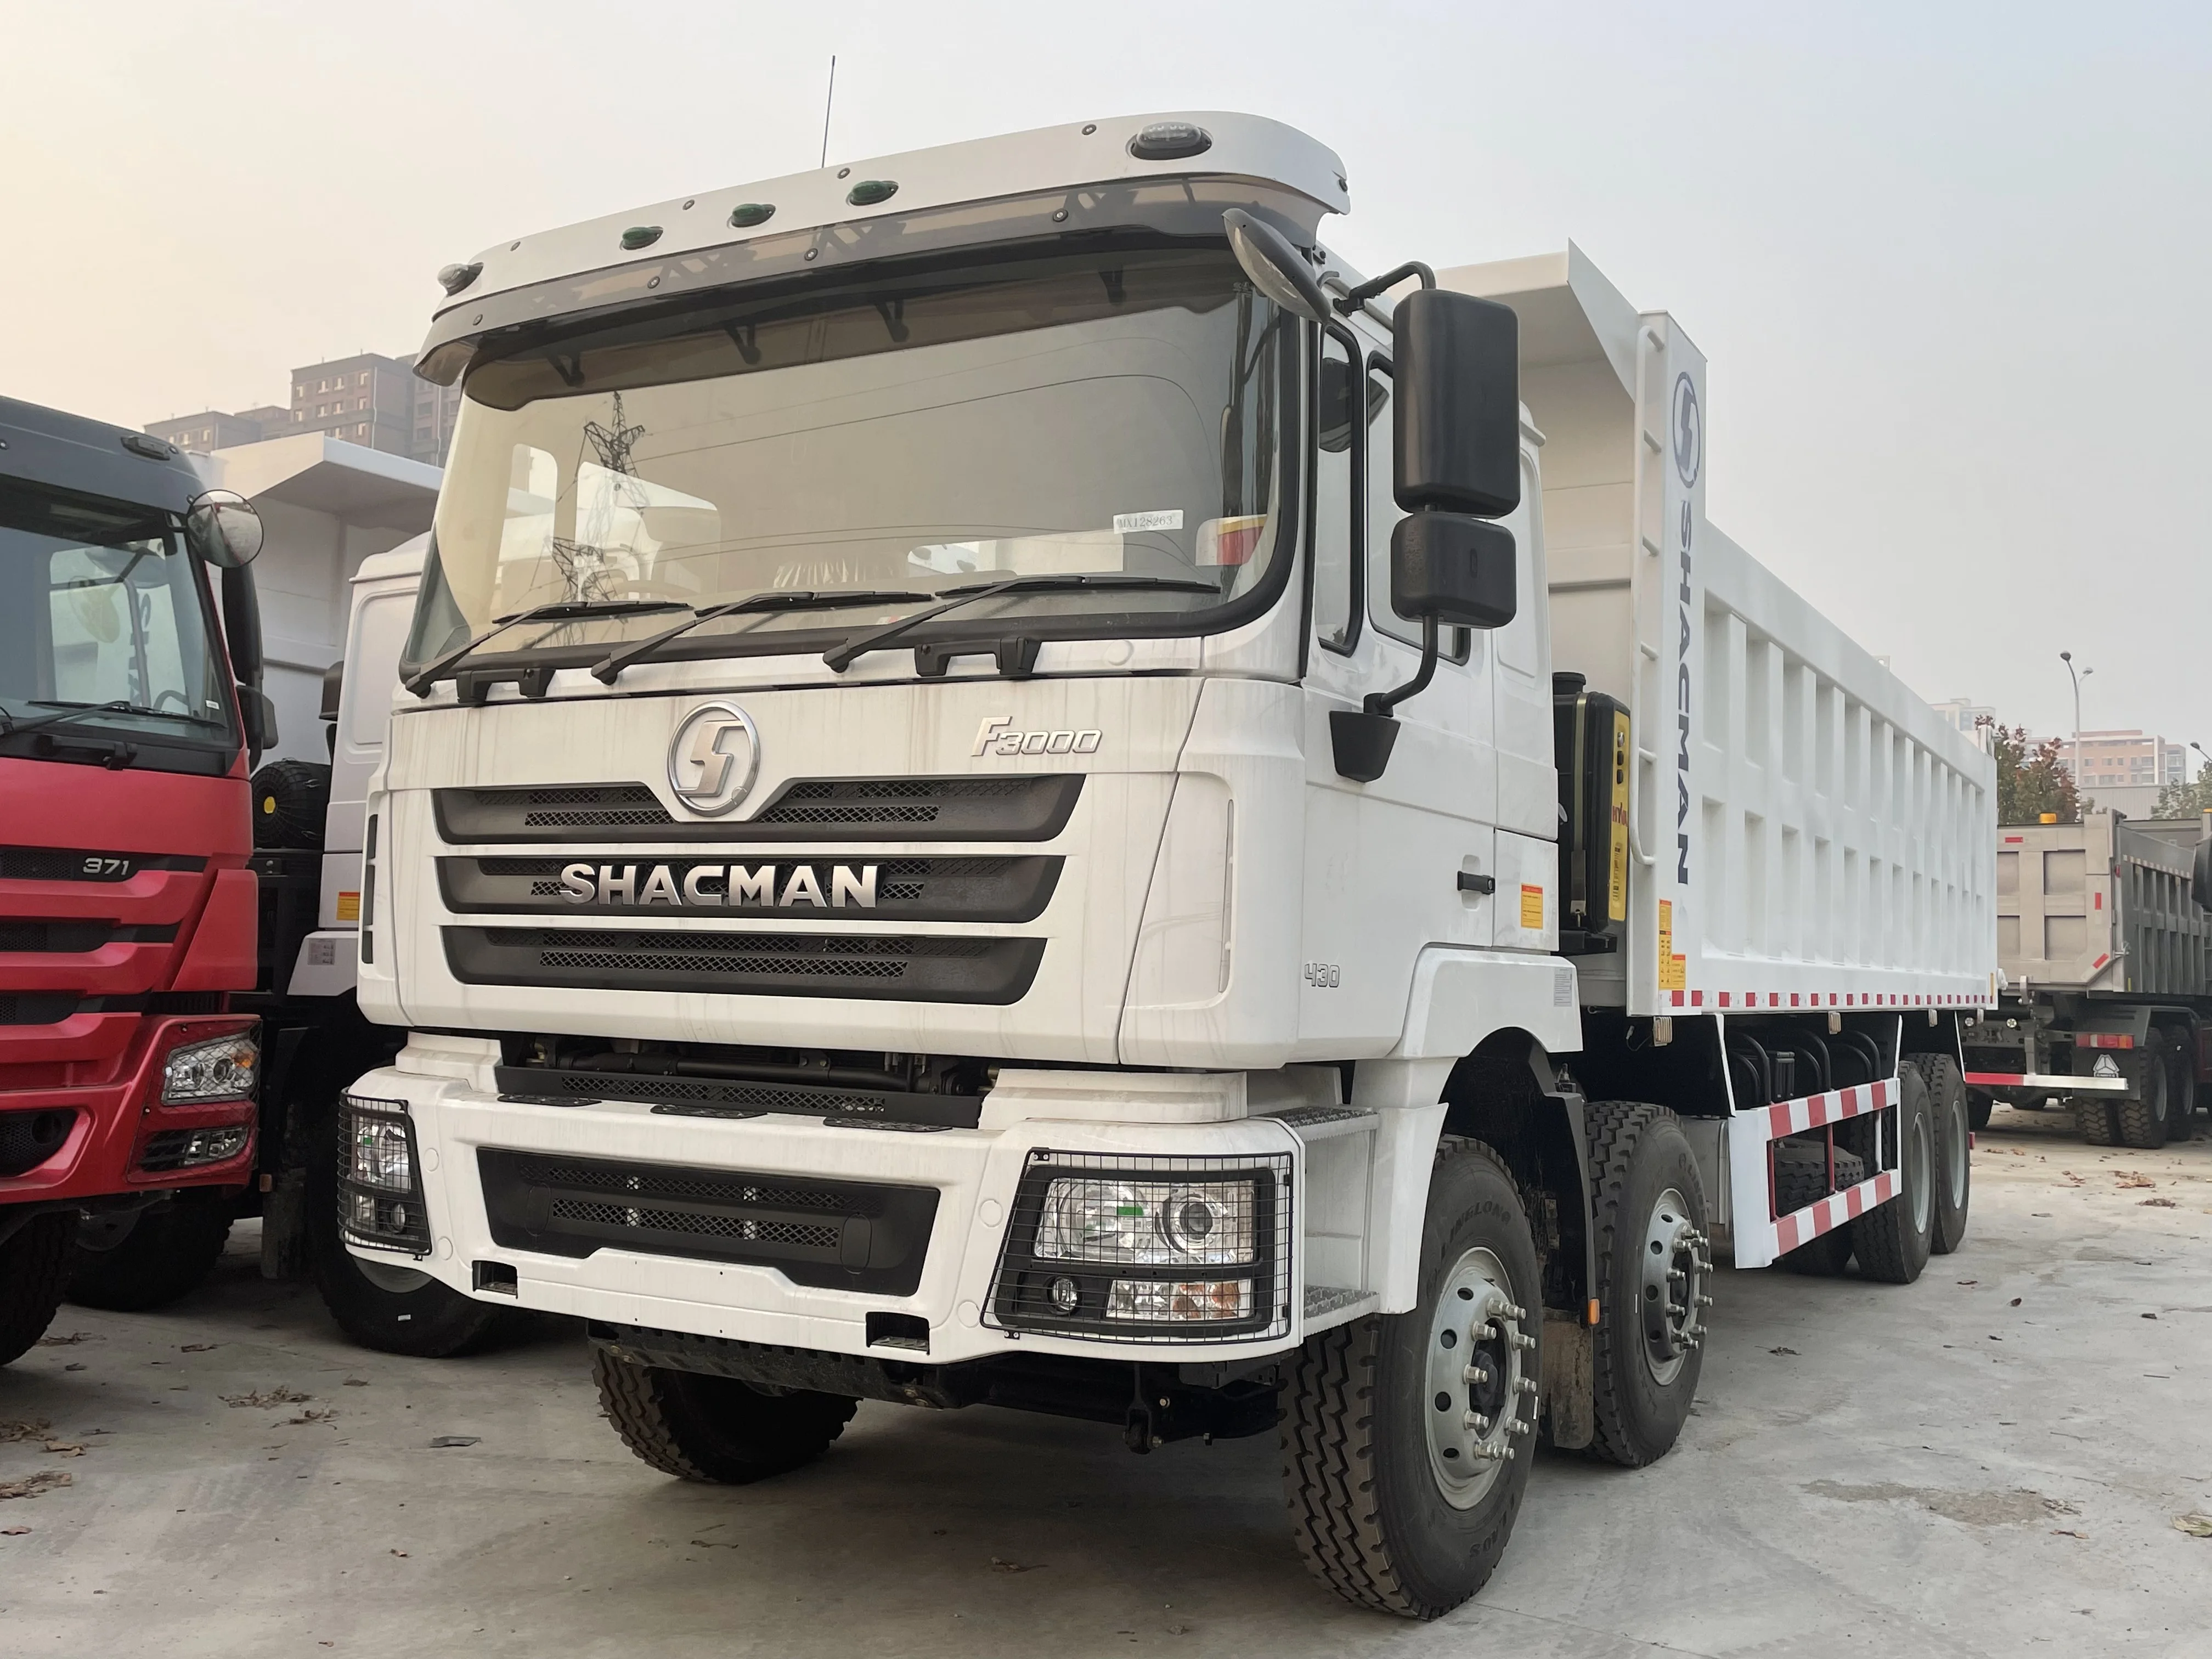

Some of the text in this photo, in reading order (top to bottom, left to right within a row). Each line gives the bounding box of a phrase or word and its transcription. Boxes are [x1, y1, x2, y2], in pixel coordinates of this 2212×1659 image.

[1677, 500, 1692, 884] SHACMAN
[970, 716, 1102, 757] F3000
[83, 857, 129, 876] 371
[559, 863, 878, 908] SHACMAN
[1304, 963, 1340, 988] 430
